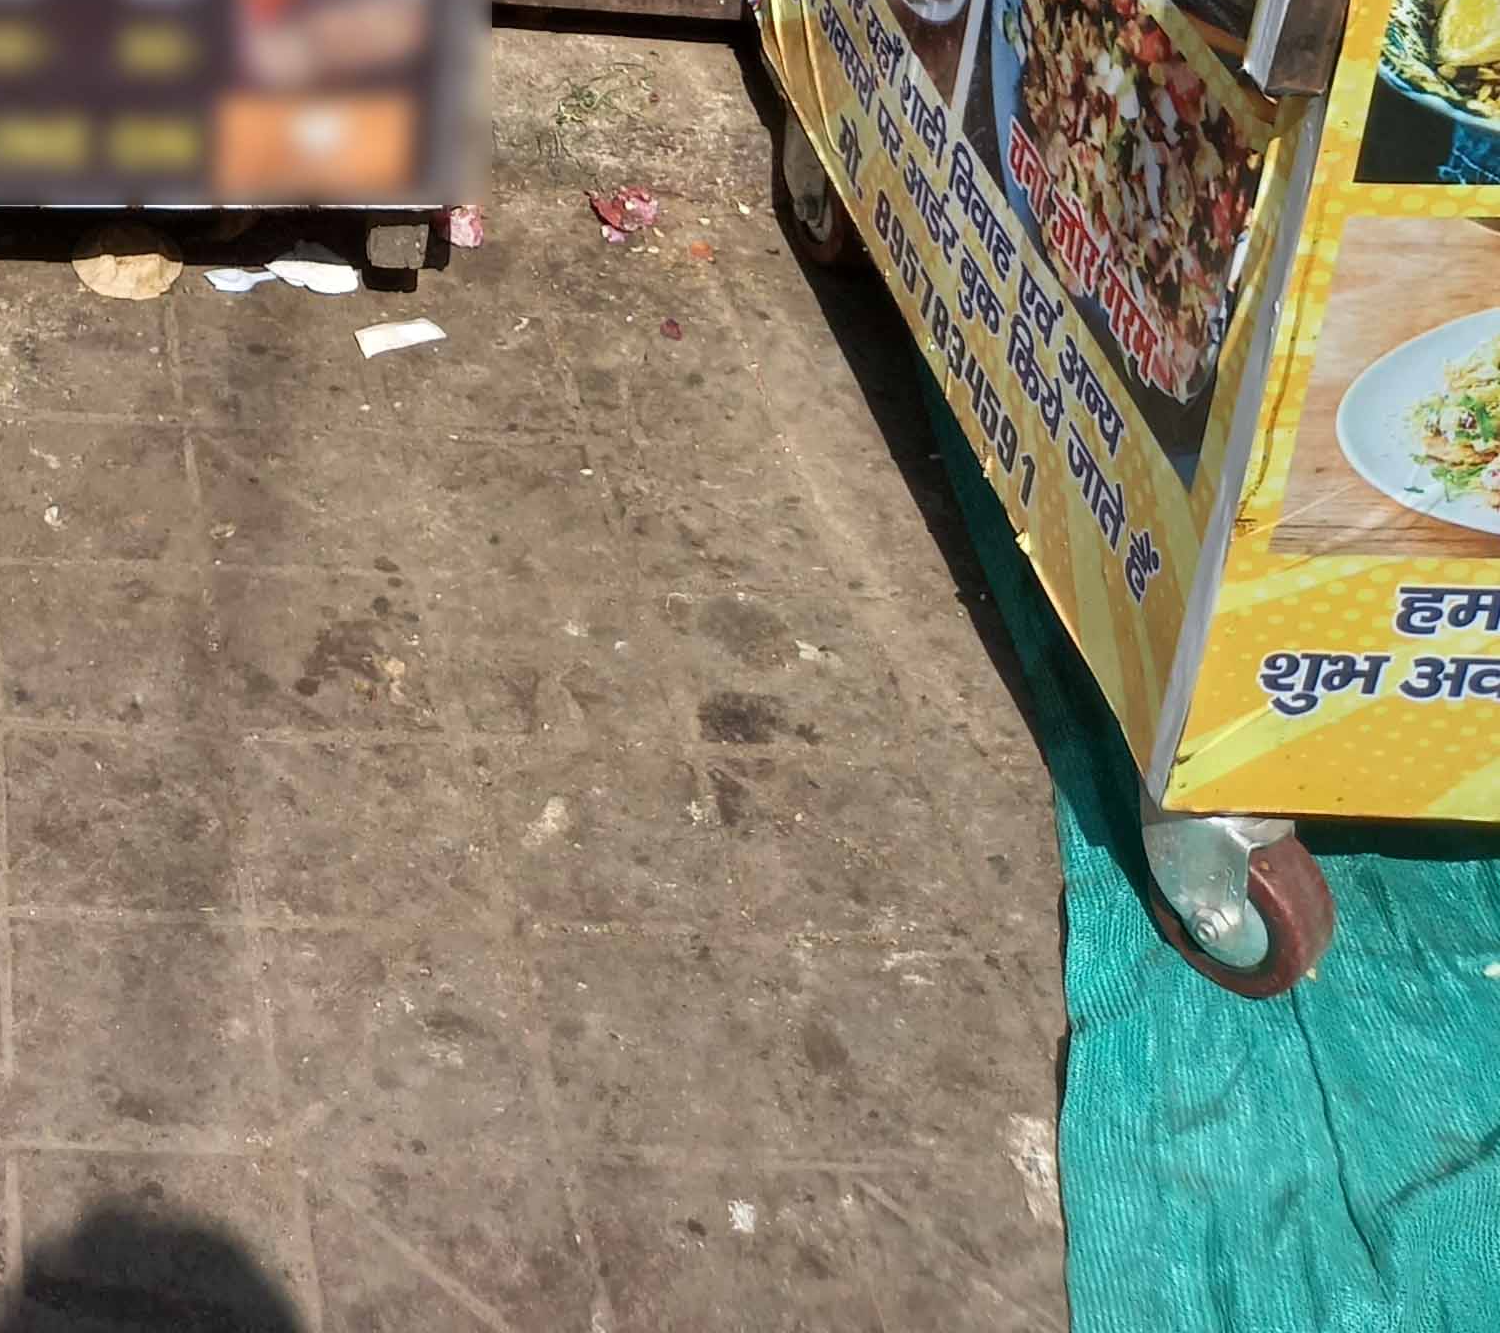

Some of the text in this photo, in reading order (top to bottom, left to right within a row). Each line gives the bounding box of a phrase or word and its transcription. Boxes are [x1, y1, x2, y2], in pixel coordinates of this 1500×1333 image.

[872, 188, 1038, 509] 8957834591
[876, 98, 904, 168] पर
[957, 243, 1005, 337] बुक
[1006, 313, 1065, 443] किये
[1066, 420, 1126, 552] जाते
[900, 73, 948, 169] शादी
[948, 141, 1017, 283] विवाह
[1019, 260, 1064, 348] एवं
[1058, 333, 1125, 459] अन्य
[1009, 118, 1162, 385] चना जोर गरम
[1259, 651, 1393, 717] शुभ
